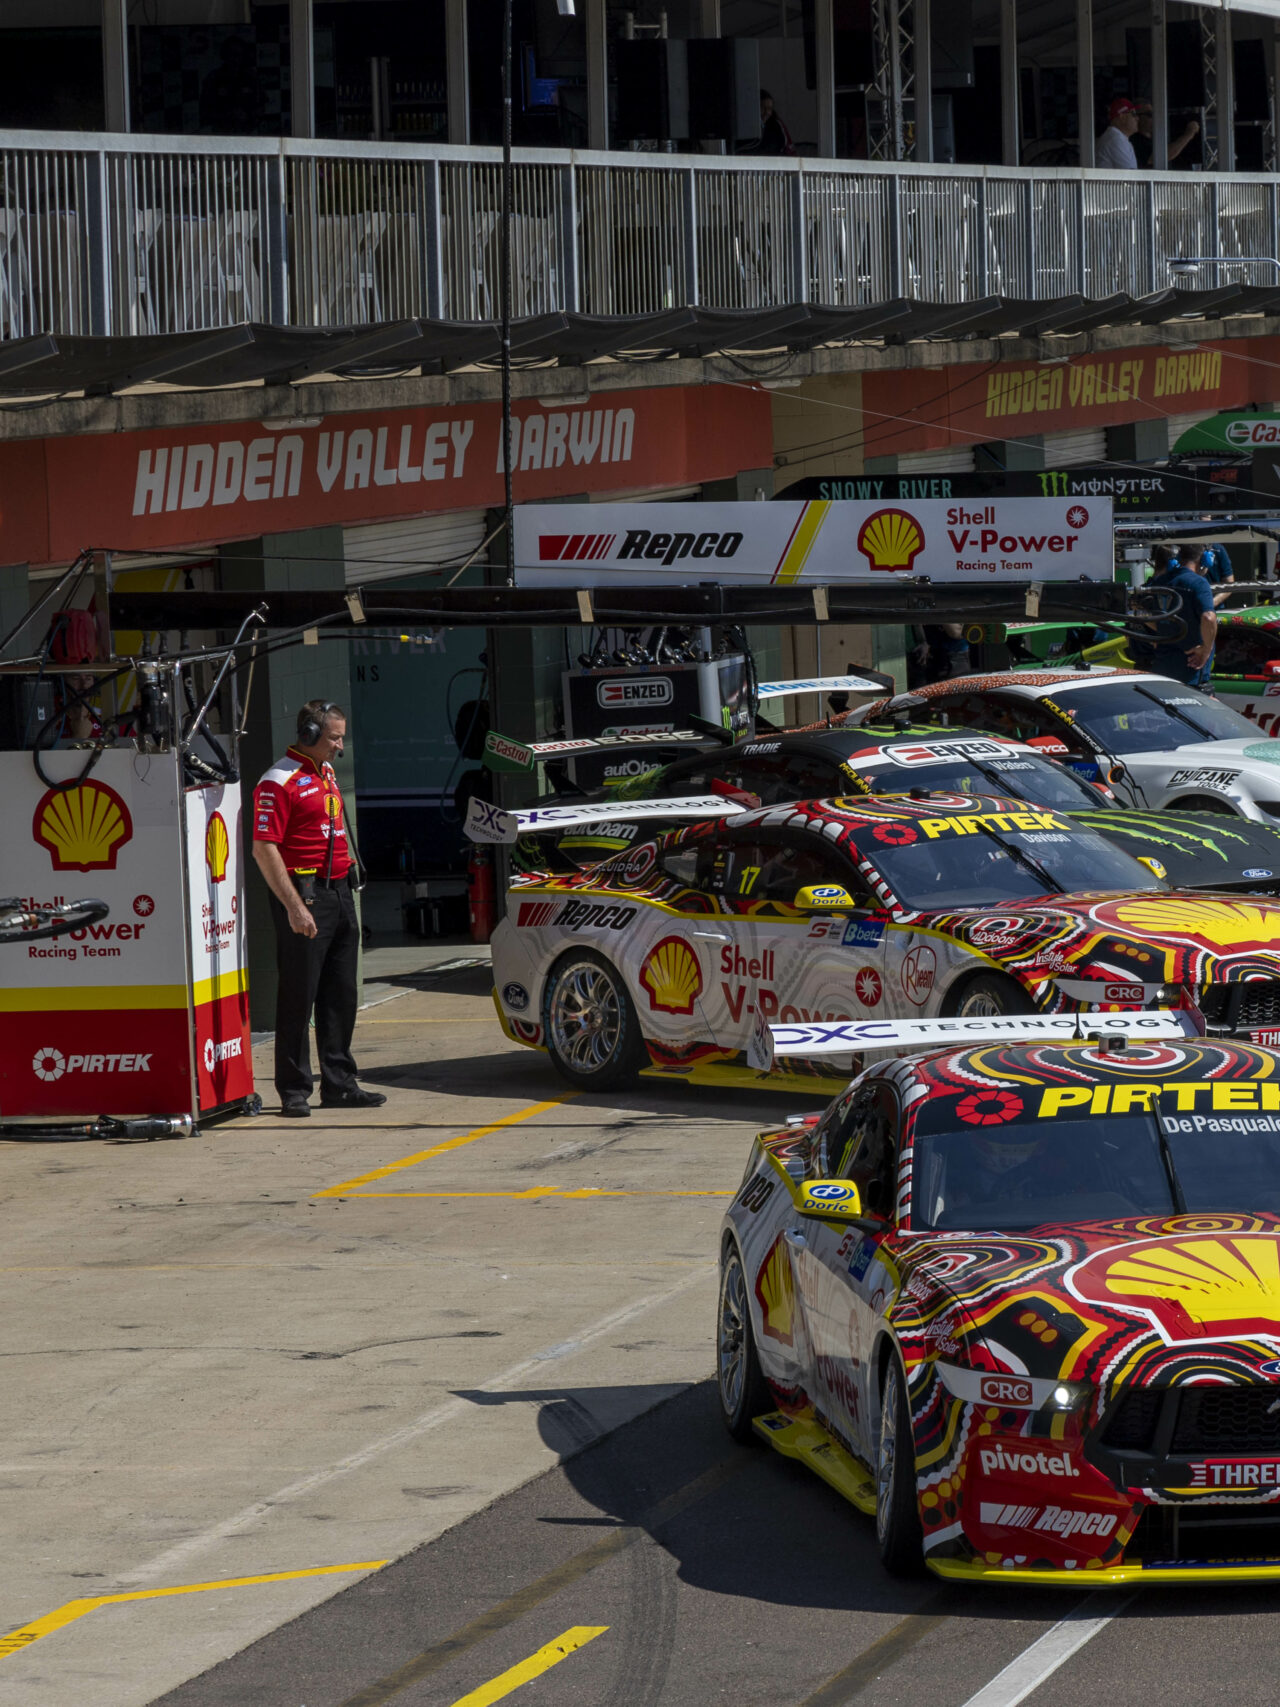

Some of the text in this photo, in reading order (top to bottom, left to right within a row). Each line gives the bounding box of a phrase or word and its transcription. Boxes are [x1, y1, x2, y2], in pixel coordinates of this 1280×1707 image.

[985, 352, 1221, 418] HIDDEN VALLEY DARWIN
[132, 408, 636, 517] HIDDEN VALLEY DARWIN
[819, 480, 952, 500] SNOWY RIVER
[1072, 477, 1165, 496] MONSTER
[946, 506, 996, 526] Shell
[617, 529, 744, 566] Repco
[946, 529, 1080, 555] V-Power
[956, 559, 1033, 574] Racing Team
[623, 685, 666, 700] ENZED
[533, 730, 704, 753] Castrol EDGE
[742, 743, 782, 755] TRADIE
[928, 741, 996, 758] ENZED
[495, 740, 529, 765] Castrol
[604, 760, 663, 776] autOba
[988, 761, 1037, 771] Waters
[1169, 770, 1241, 786] CHICANE
[1197, 782, 1229, 791] TOOLS
[575, 798, 733, 817] TECHNOLOGY
[472, 801, 505, 835] DXC
[918, 813, 1071, 839] PIRTEK
[1019, 832, 1072, 842] Davison
[739, 865, 762, 895] 17
[1245, 869, 1271, 877] Ford
[552, 900, 638, 931] Repco
[202, 918, 236, 941] V-Power
[857, 927, 881, 942] betr
[28, 945, 121, 961] Racing Team
[205, 940, 231, 954] Racing Team
[720, 944, 775, 982] Shell
[1036, 951, 1064, 969] Instyle
[1054, 962, 1078, 975] Solar
[903, 957, 937, 995] Rheem
[1108, 985, 1143, 1000] CRC
[770, 1015, 1186, 1047] DXC TECHNOLOGY
[215, 1036, 242, 1063] PIRTEK
[66, 1053, 153, 1073] PIRTEK
[1163, 1117, 1193, 1134] De
[803, 1199, 849, 1214] Doric
[938, 1336, 960, 1355] Solar
[983, 1380, 1032, 1402] CRC
[980, 1444, 1080, 1477] pivotel.
[1034, 1504, 1118, 1539] Repco
